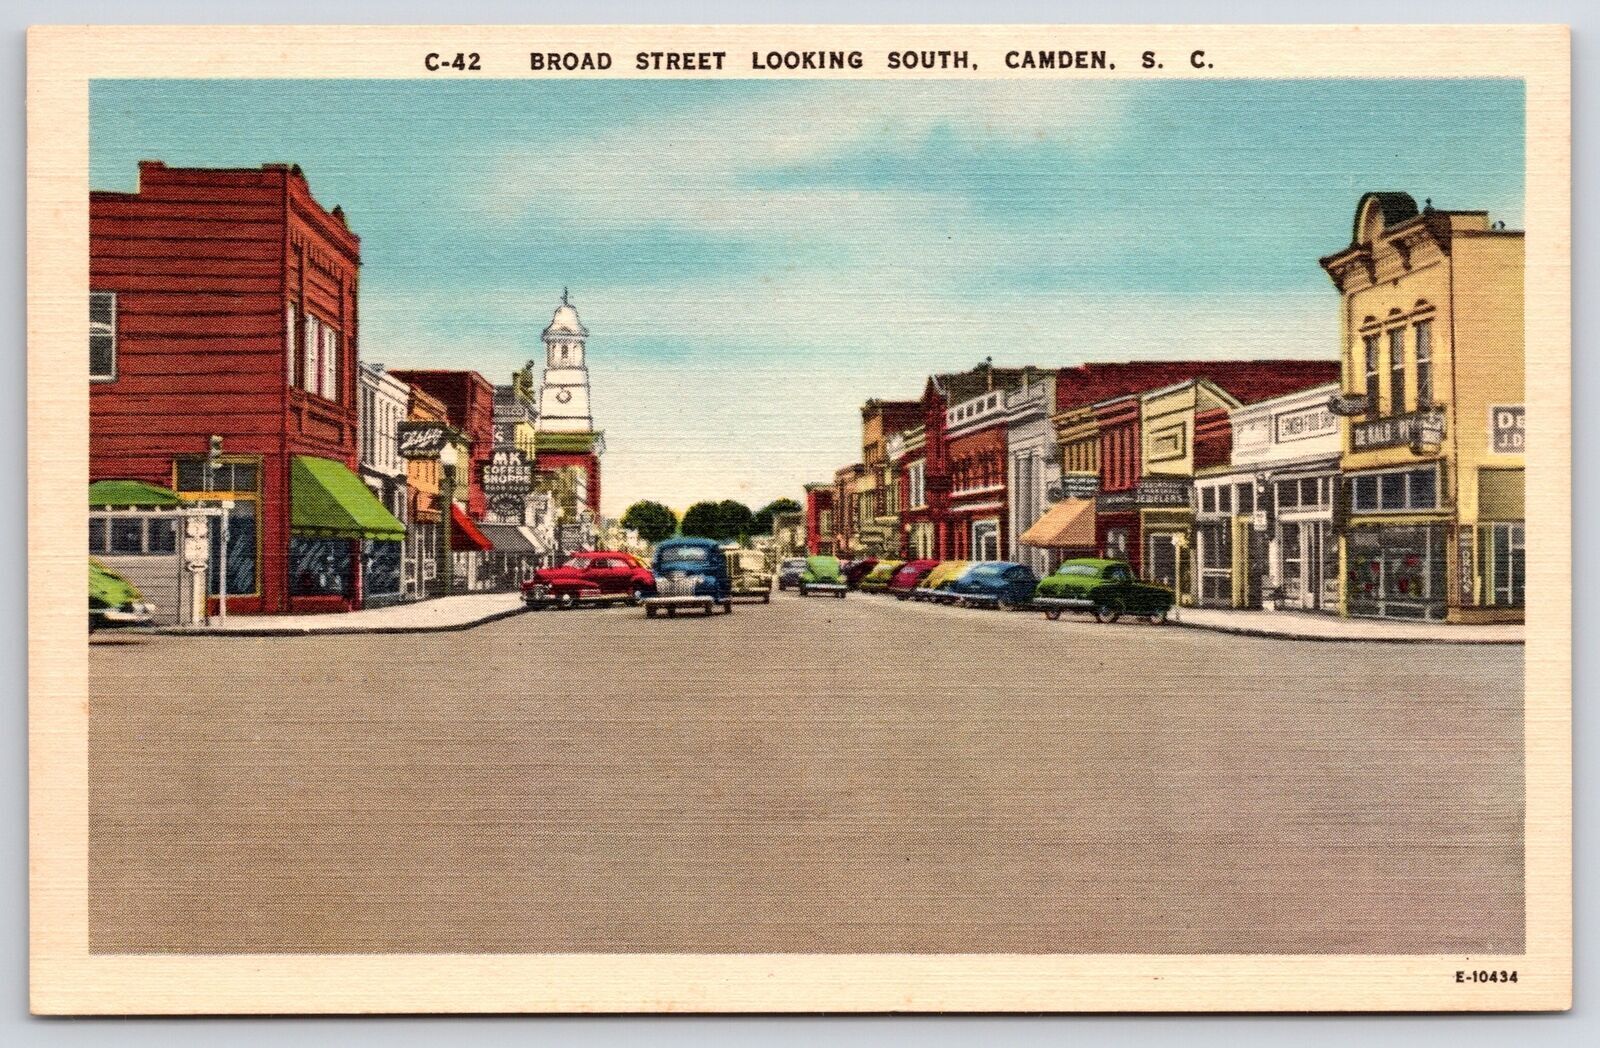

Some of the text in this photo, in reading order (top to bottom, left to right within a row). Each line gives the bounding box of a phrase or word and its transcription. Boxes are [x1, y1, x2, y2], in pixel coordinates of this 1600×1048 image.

[425, 51, 1214, 71] C-42 BROAD STREET LOOKING SOUTH, CAMDEN, S. C.
[483, 465, 532, 475] COFFEE
[483, 475, 532, 484] SHOPPE
[1455, 970, 1519, 984] E-10434
